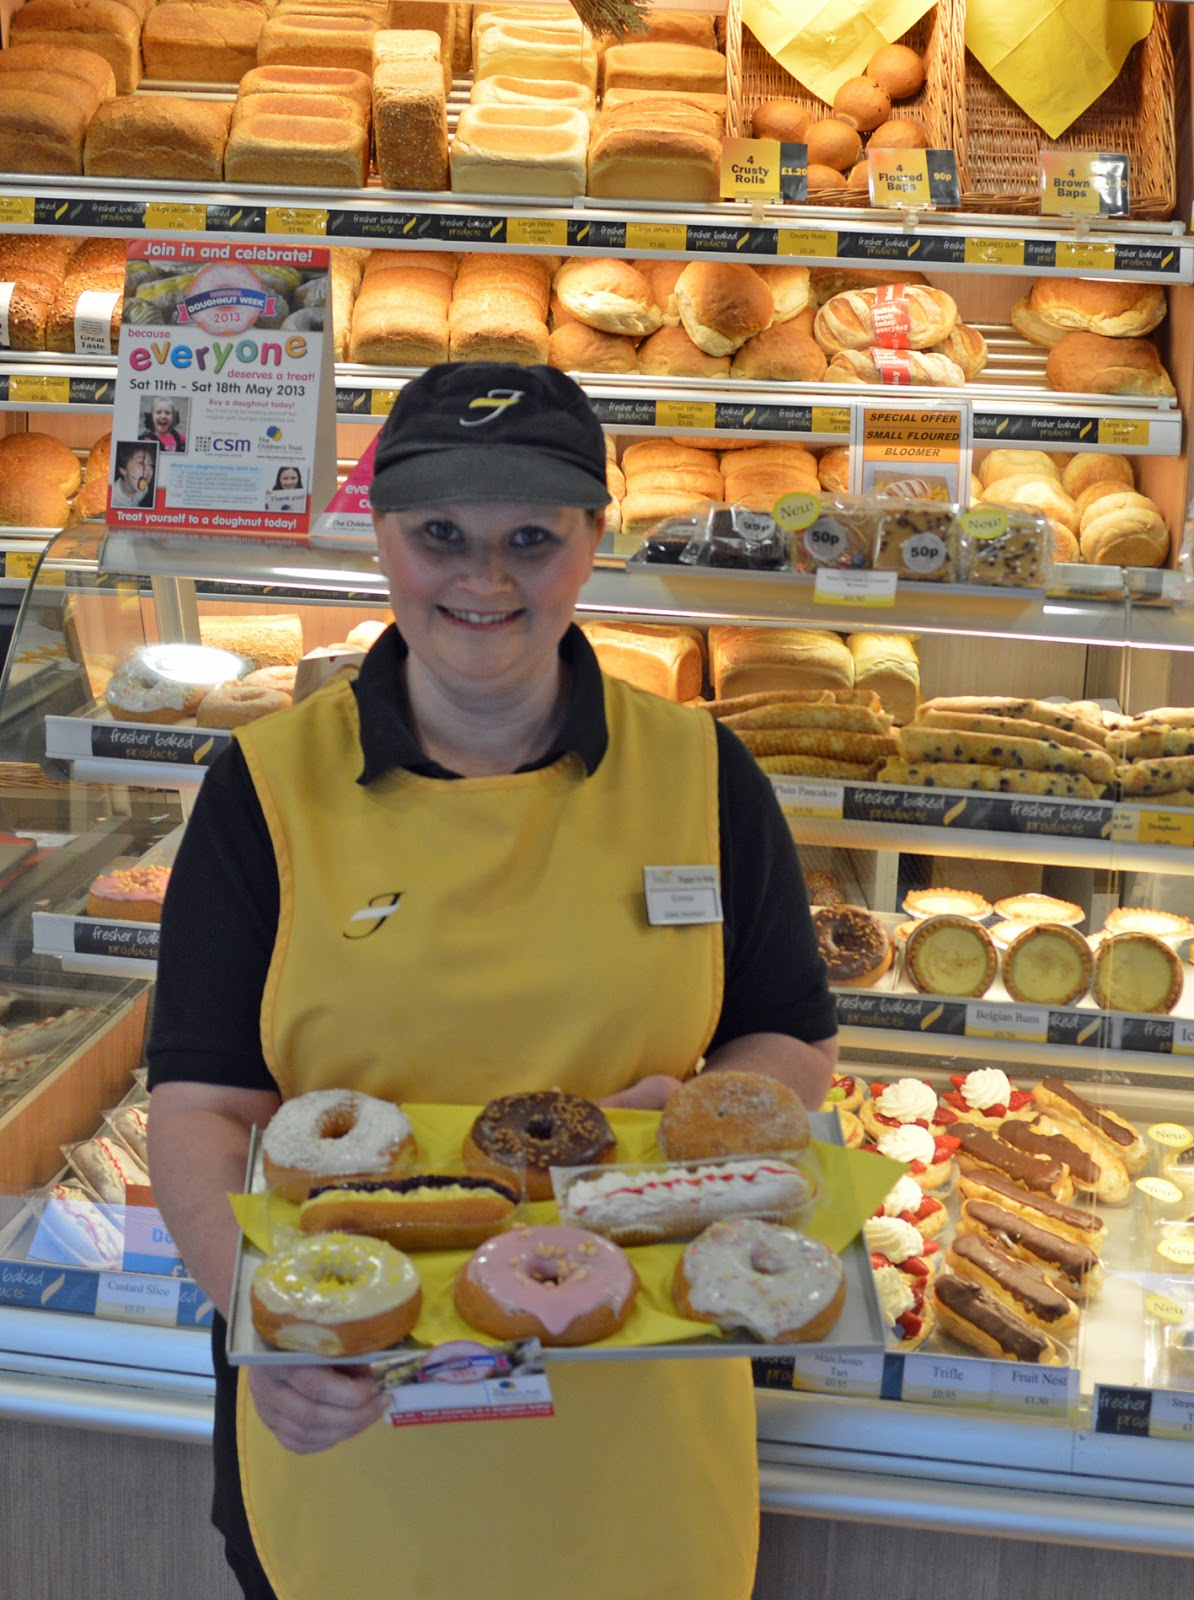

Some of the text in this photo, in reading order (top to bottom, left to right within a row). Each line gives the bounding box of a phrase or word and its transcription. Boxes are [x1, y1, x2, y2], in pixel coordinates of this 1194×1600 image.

[746, 155, 754, 164] 4
[731, 164, 769, 177] Crusty
[781, 166, 807, 176] £1.20
[896, 164, 903, 172] 4
[1068, 168, 1076, 177] 4
[735, 174, 765, 184] Rolls
[878, 172, 923, 182] Floured
[933, 172, 952, 182] 90p
[887, 182, 916, 192] Baps
[1053, 178, 1090, 188] Brown
[1057, 188, 1087, 199] Baps
[353, 213, 405, 225] fresher baked
[440, 218, 464, 228] fresher
[362, 224, 395, 233] products
[449, 228, 481, 237] products
[600, 226, 625, 236] fresher
[687, 230, 738, 240] fresher baked
[695, 240, 728, 249] products
[858, 237, 909, 248] fresher baked
[943, 241, 965, 250] freshe
[144, 242, 313, 263] Join in and celebrate!
[867, 247, 899, 256] products
[1028, 244, 1053, 254] fresher
[1138, 250, 1163, 259] baked
[1121, 259, 1152, 267] products
[187, 296, 264, 313] DOUGHNUT WEEK
[213, 312, 241, 323] 2013
[128, 328, 171, 338] because
[80, 335, 105, 343] Great
[81, 342, 105, 351] Taste
[129, 335, 308, 374] everyone
[227, 368, 315, 381] deserves a treat!
[129, 379, 150, 390] Sat
[154, 379, 177, 391] 11th
[191, 381, 212, 393] Sat
[216, 381, 241, 394] 18th
[246, 384, 271, 398] May
[274, 384, 305, 397] 2013
[208, 398, 222, 406] Buy
[232, 399, 269, 408] doughnut
[271, 401, 295, 409] today!
[608, 402, 656, 413] fresher bake
[720, 407, 744, 416] baked
[779, 409, 802, 418] fresher
[869, 413, 957, 423] SPECIAL OFFER
[1031, 418, 1081, 429] fresher baked
[866, 431, 960, 441] SMALL FLOURED
[1039, 428, 1072, 438] products
[212, 438, 251, 452] csm
[884, 447, 940, 457] BLOOMER
[117, 511, 297, 530] Treat yourself to a doughnut today!
[811, 530, 840, 546] 50p
[910, 546, 939, 559] 50p
[110, 728, 194, 749] fresher baked
[126, 746, 178, 761] products
[854, 788, 945, 810] fresher baked
[869, 807, 927, 822] products
[1010, 801, 1104, 822] fresher baked
[1025, 819, 1084, 835] products
[92, 926, 160, 945] fresher bak
[880, 997, 922, 1015] baked
[846, 1012, 905, 1027] products
[976, 1009, 1040, 1024] Belgian Buns
[1183, 1028, 1194, 1042] Ic
[2, 1267, 44, 1286] baked
[107, 1280, 145, 1296] Custard
[146, 1284, 170, 1297] Slice
[815, 1353, 864, 1367] Manchester
[830, 1366, 848, 1377] Tart
[932, 1366, 964, 1381] Trifle
[1012, 1370, 1068, 1386] Fruit Nest
[1100, 1391, 1147, 1411] fresher
